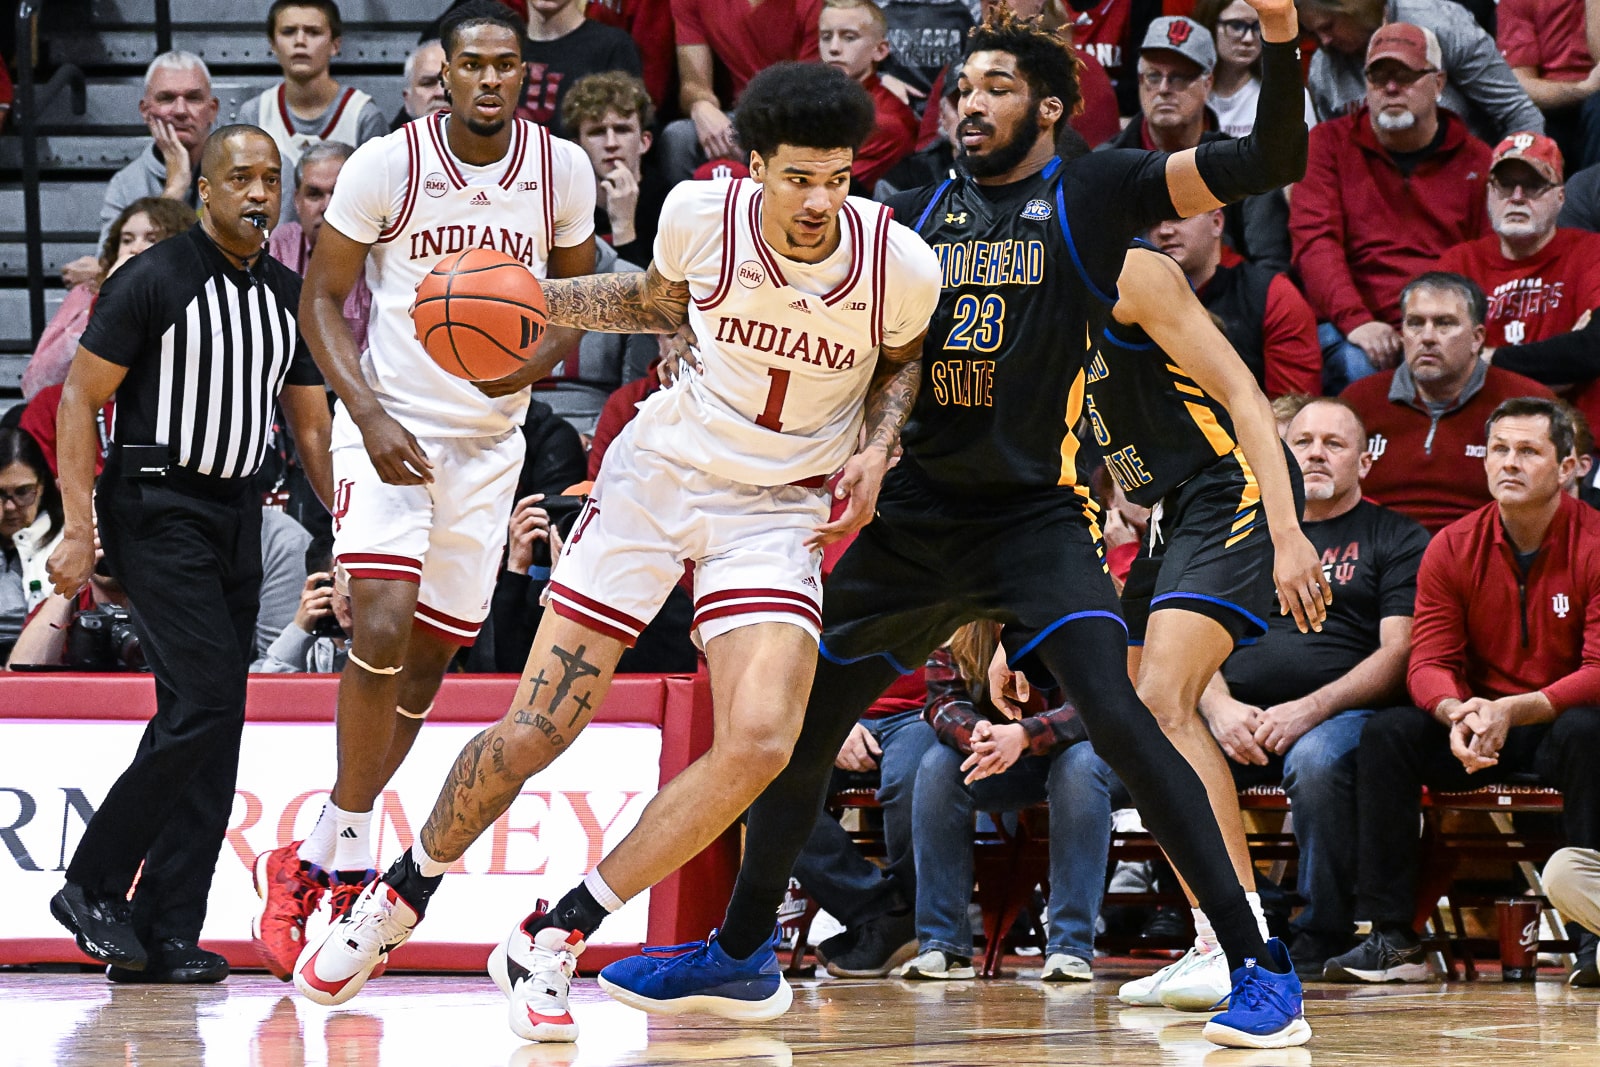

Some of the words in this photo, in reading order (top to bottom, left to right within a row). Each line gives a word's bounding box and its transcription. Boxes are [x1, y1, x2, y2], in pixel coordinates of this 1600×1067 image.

[425, 180, 446, 191] RMK
[410, 224, 533, 268] INDIANA
[739, 267, 761, 283] RMK
[715, 316, 856, 370] INDIANA
[943, 293, 1006, 353] 23
[755, 367, 791, 433] 1
[931, 360, 996, 407] STATE
